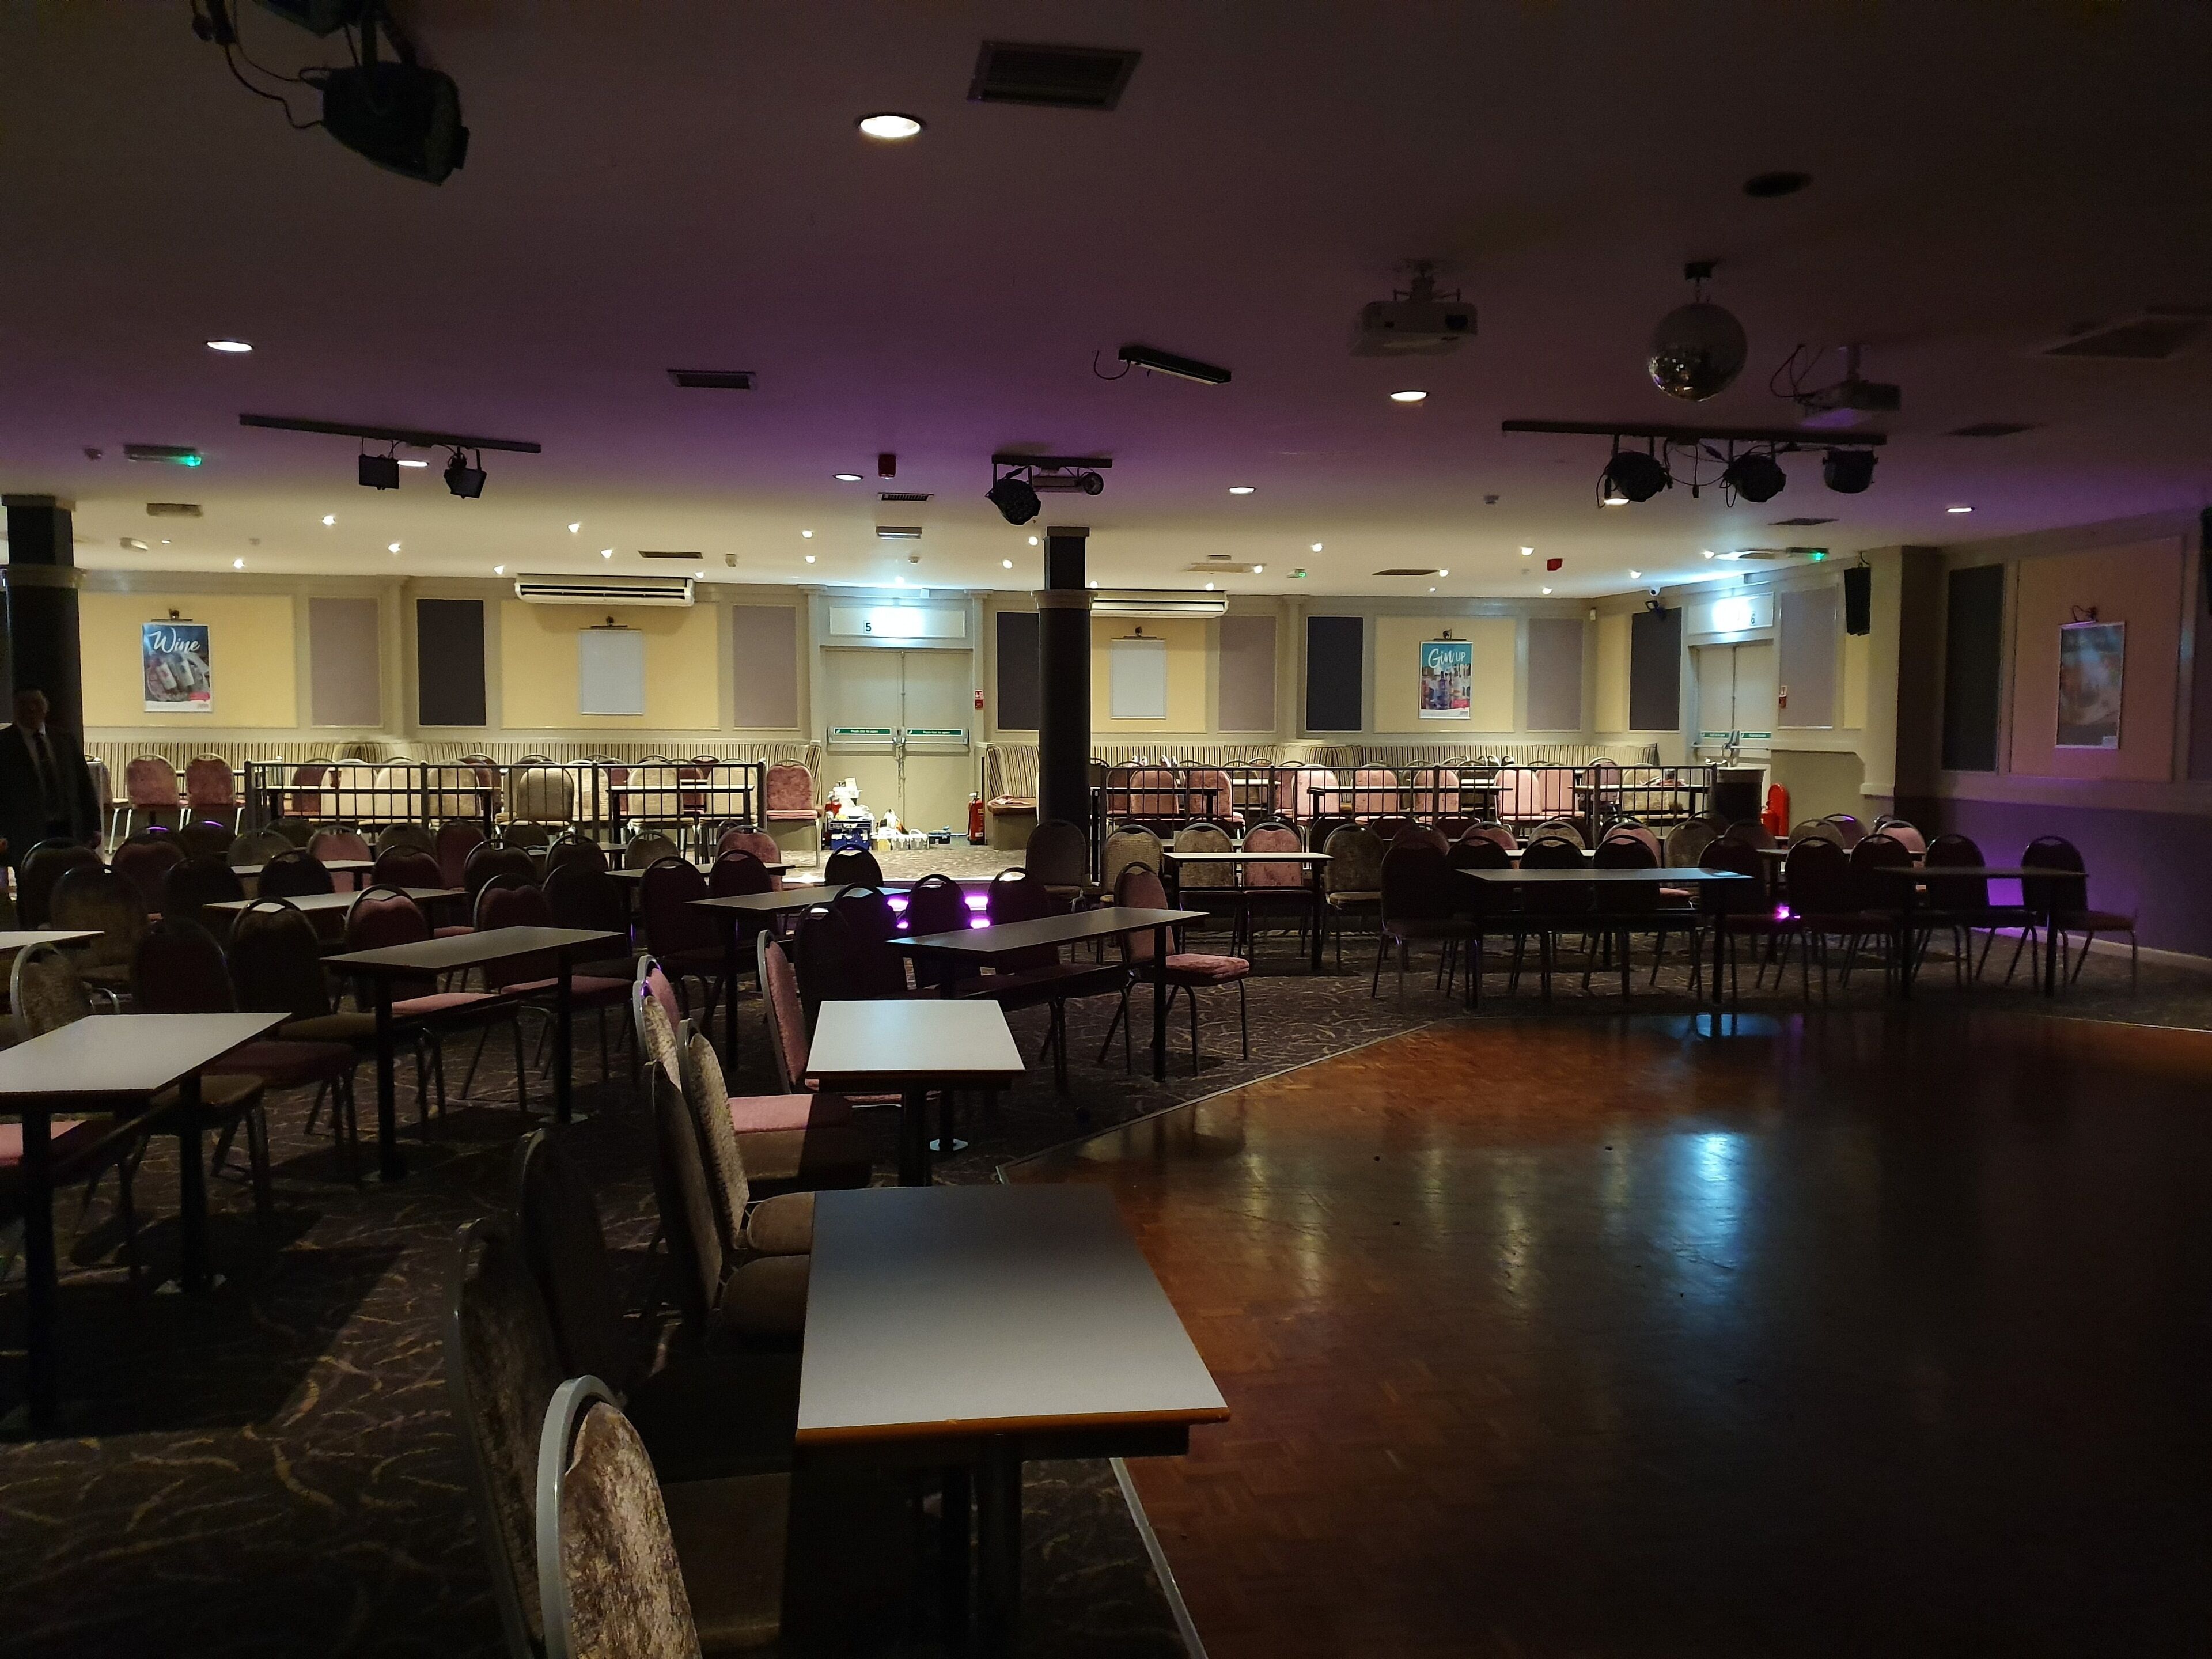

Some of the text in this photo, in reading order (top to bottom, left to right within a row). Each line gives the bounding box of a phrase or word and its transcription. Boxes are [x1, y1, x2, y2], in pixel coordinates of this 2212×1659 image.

[1751, 613, 1755, 624] 6
[865, 623, 872, 632] 5
[148, 627, 200, 653] Wine
[1428, 648, 1466, 668] Gin UP
